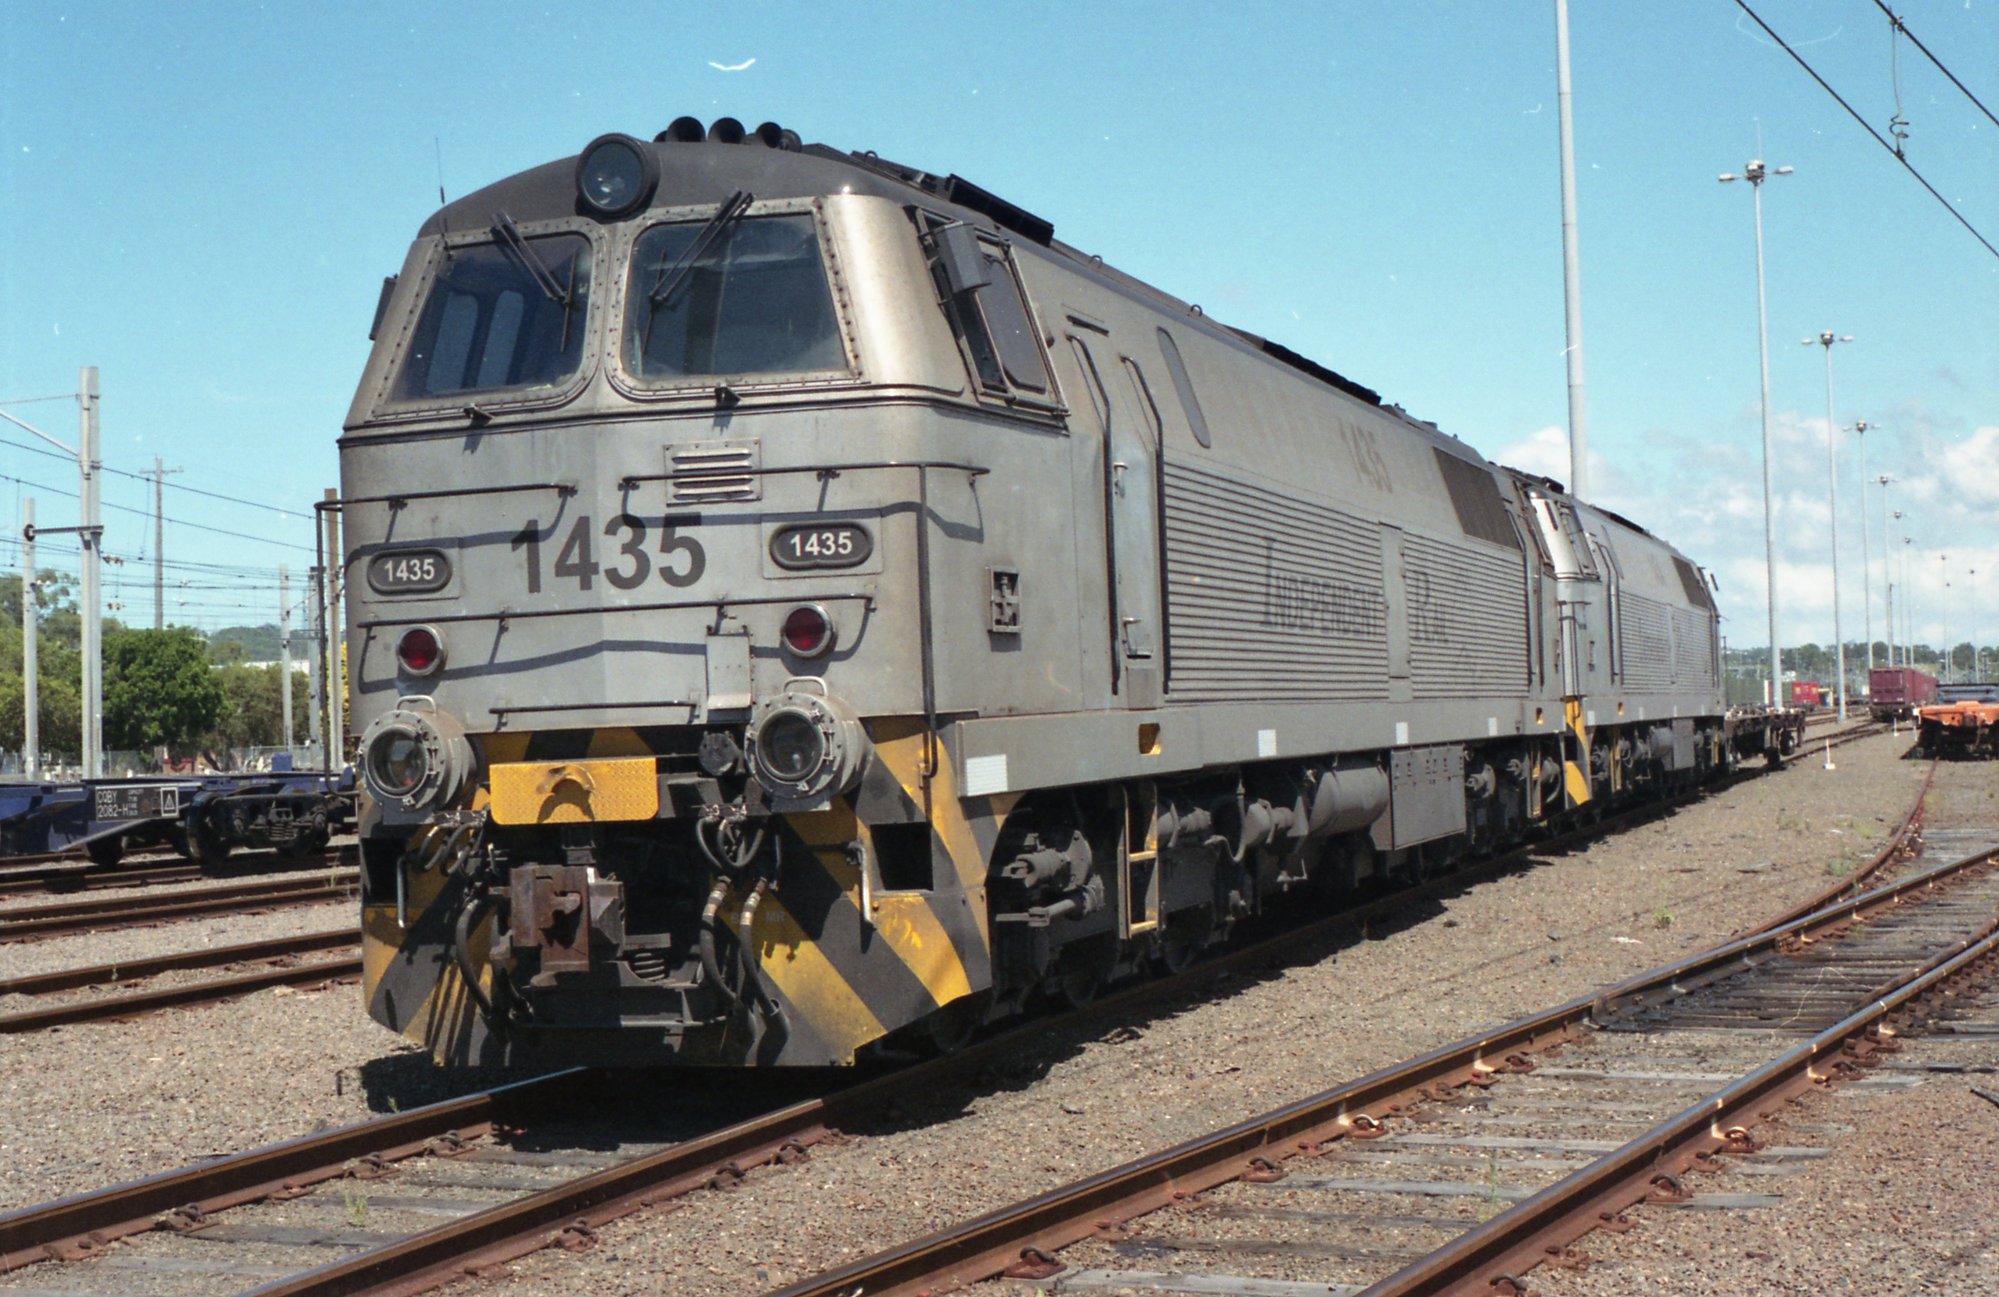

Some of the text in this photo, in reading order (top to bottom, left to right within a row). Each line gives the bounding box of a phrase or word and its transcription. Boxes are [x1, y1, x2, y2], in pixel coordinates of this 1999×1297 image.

[511, 512, 706, 594] 1435
[789, 531, 853, 557] 1435
[384, 558, 435, 582] 1435
